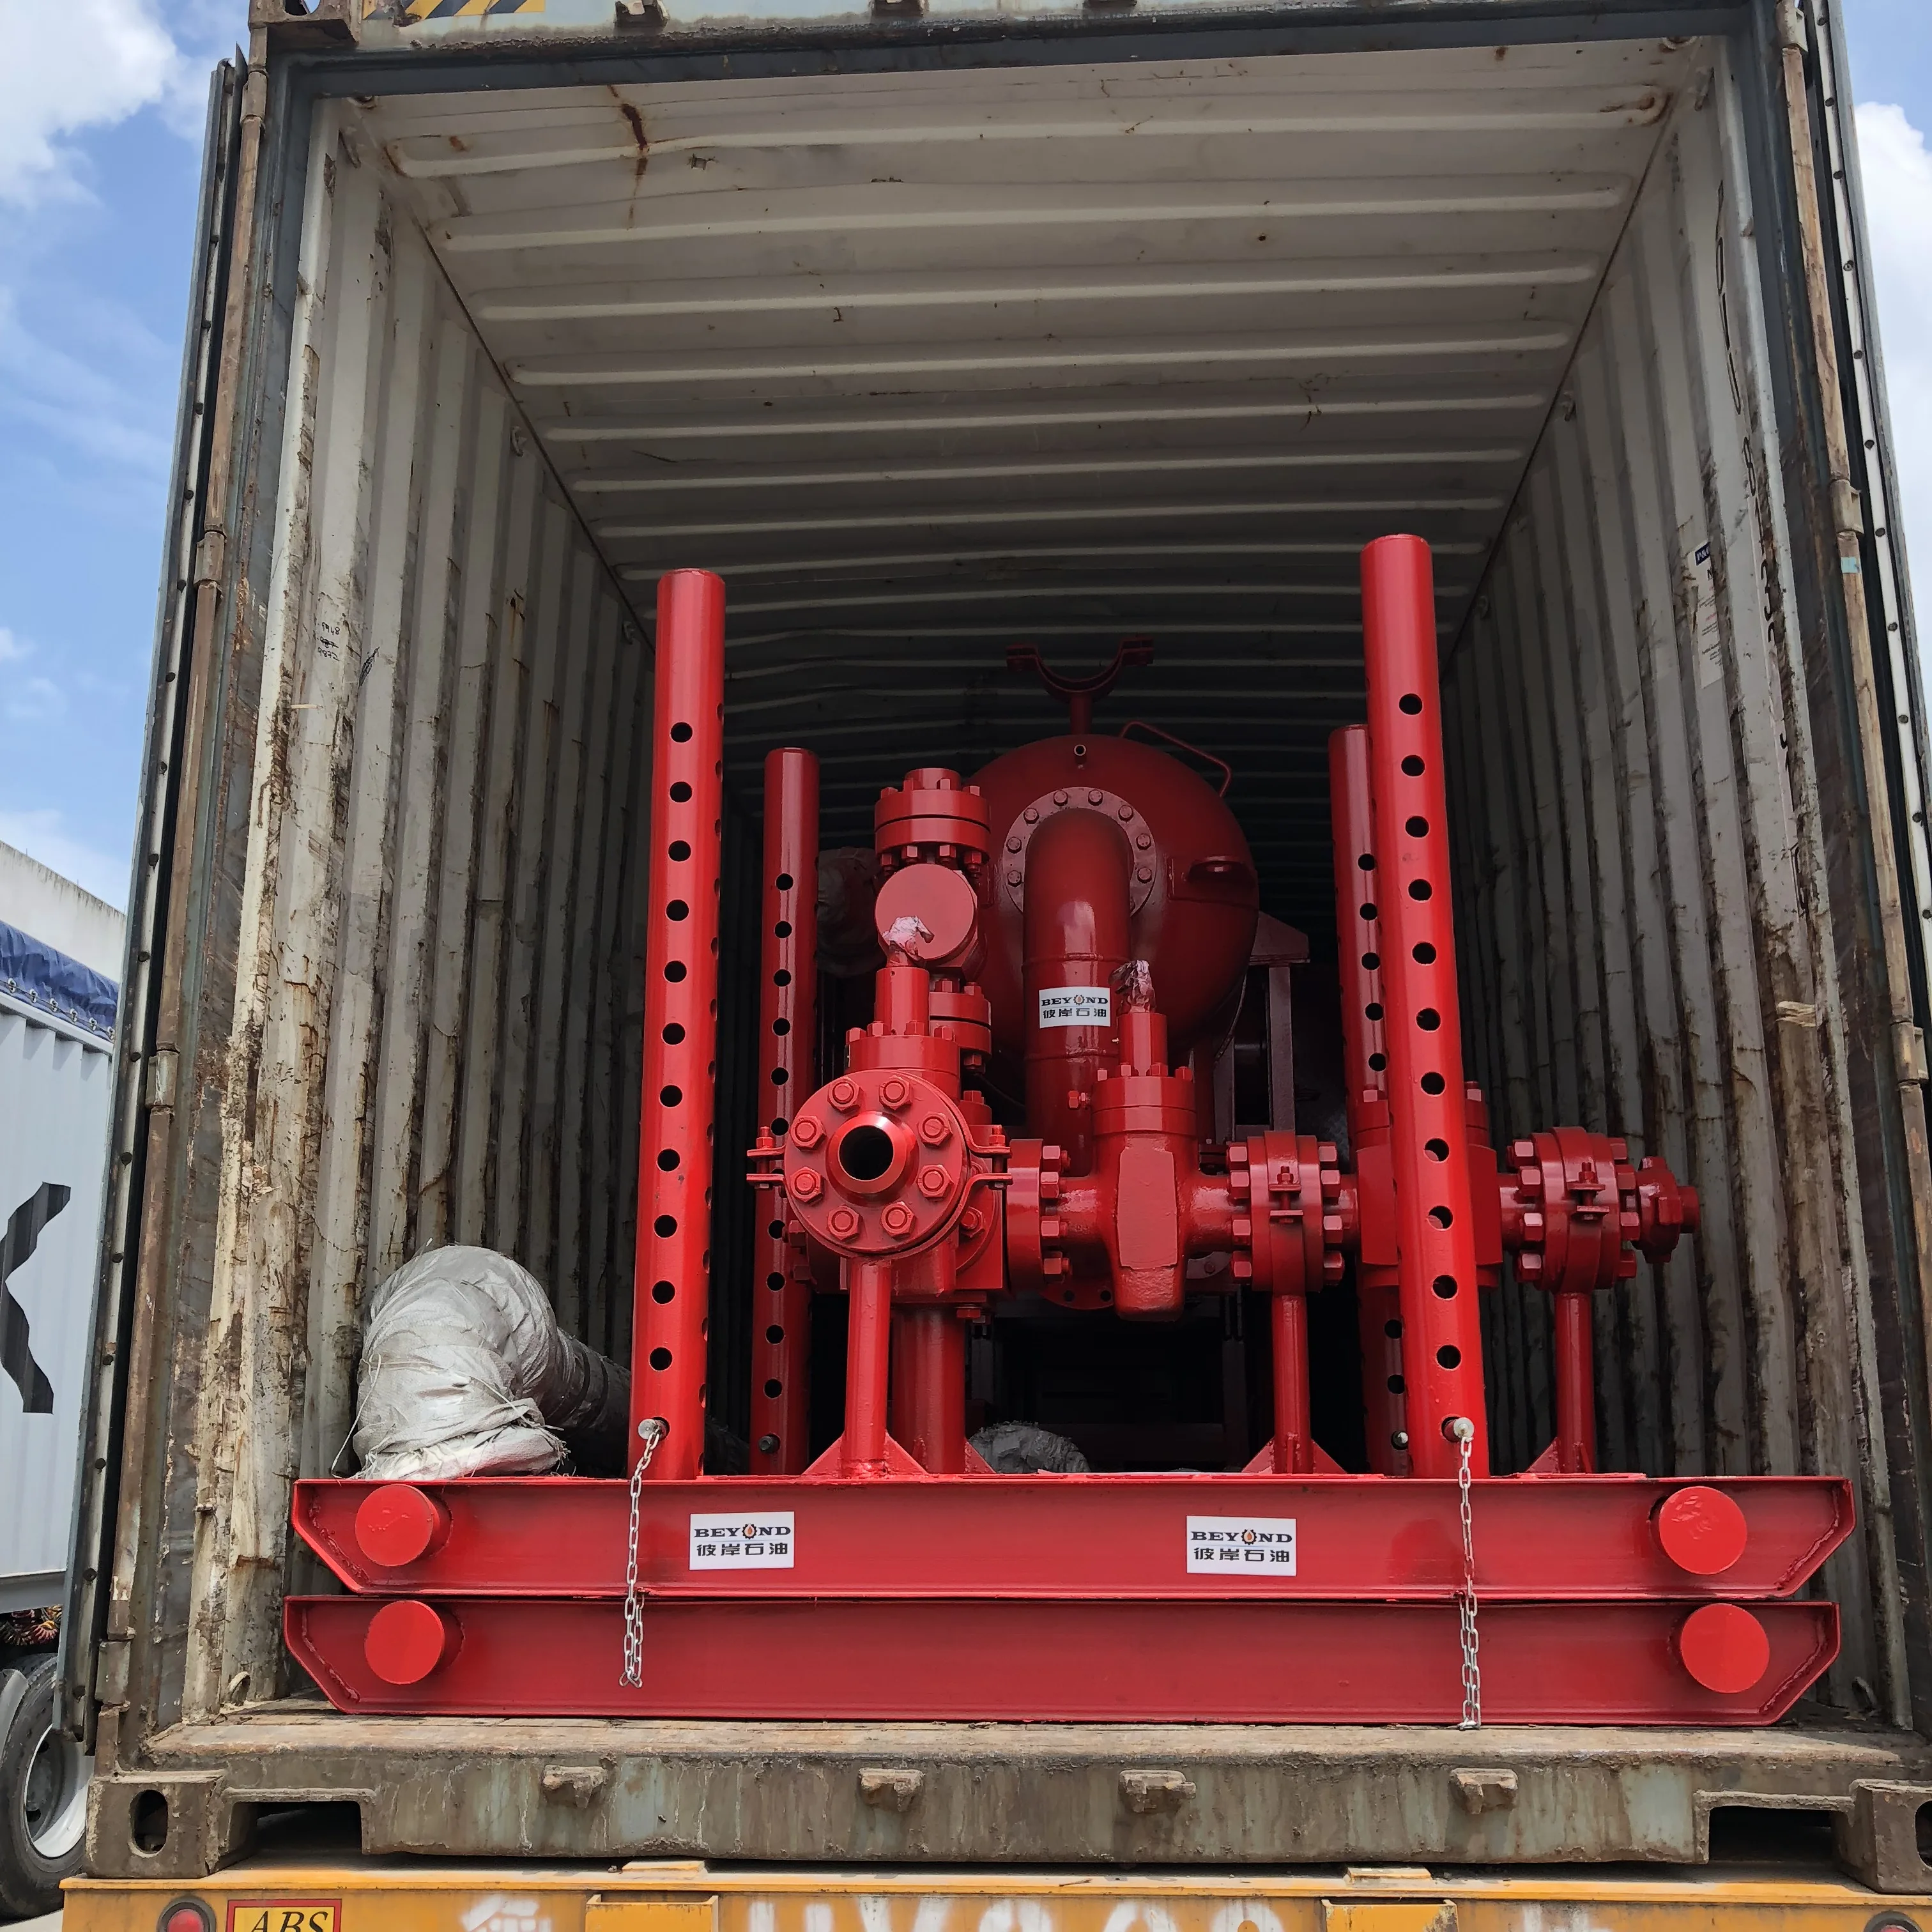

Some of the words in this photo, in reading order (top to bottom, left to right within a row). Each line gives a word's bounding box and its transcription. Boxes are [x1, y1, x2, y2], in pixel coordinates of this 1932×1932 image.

[1041, 994, 1108, 1006] BEYOND
[1043, 1008, 1107, 1019] 彼岸石油
[694, 1523, 791, 1540] BEYOND
[1190, 1528, 1292, 1545] BEYOND
[696, 1542, 788, 1556] 彼岸石油
[1193, 1547, 1290, 1563] 彼岸石油
